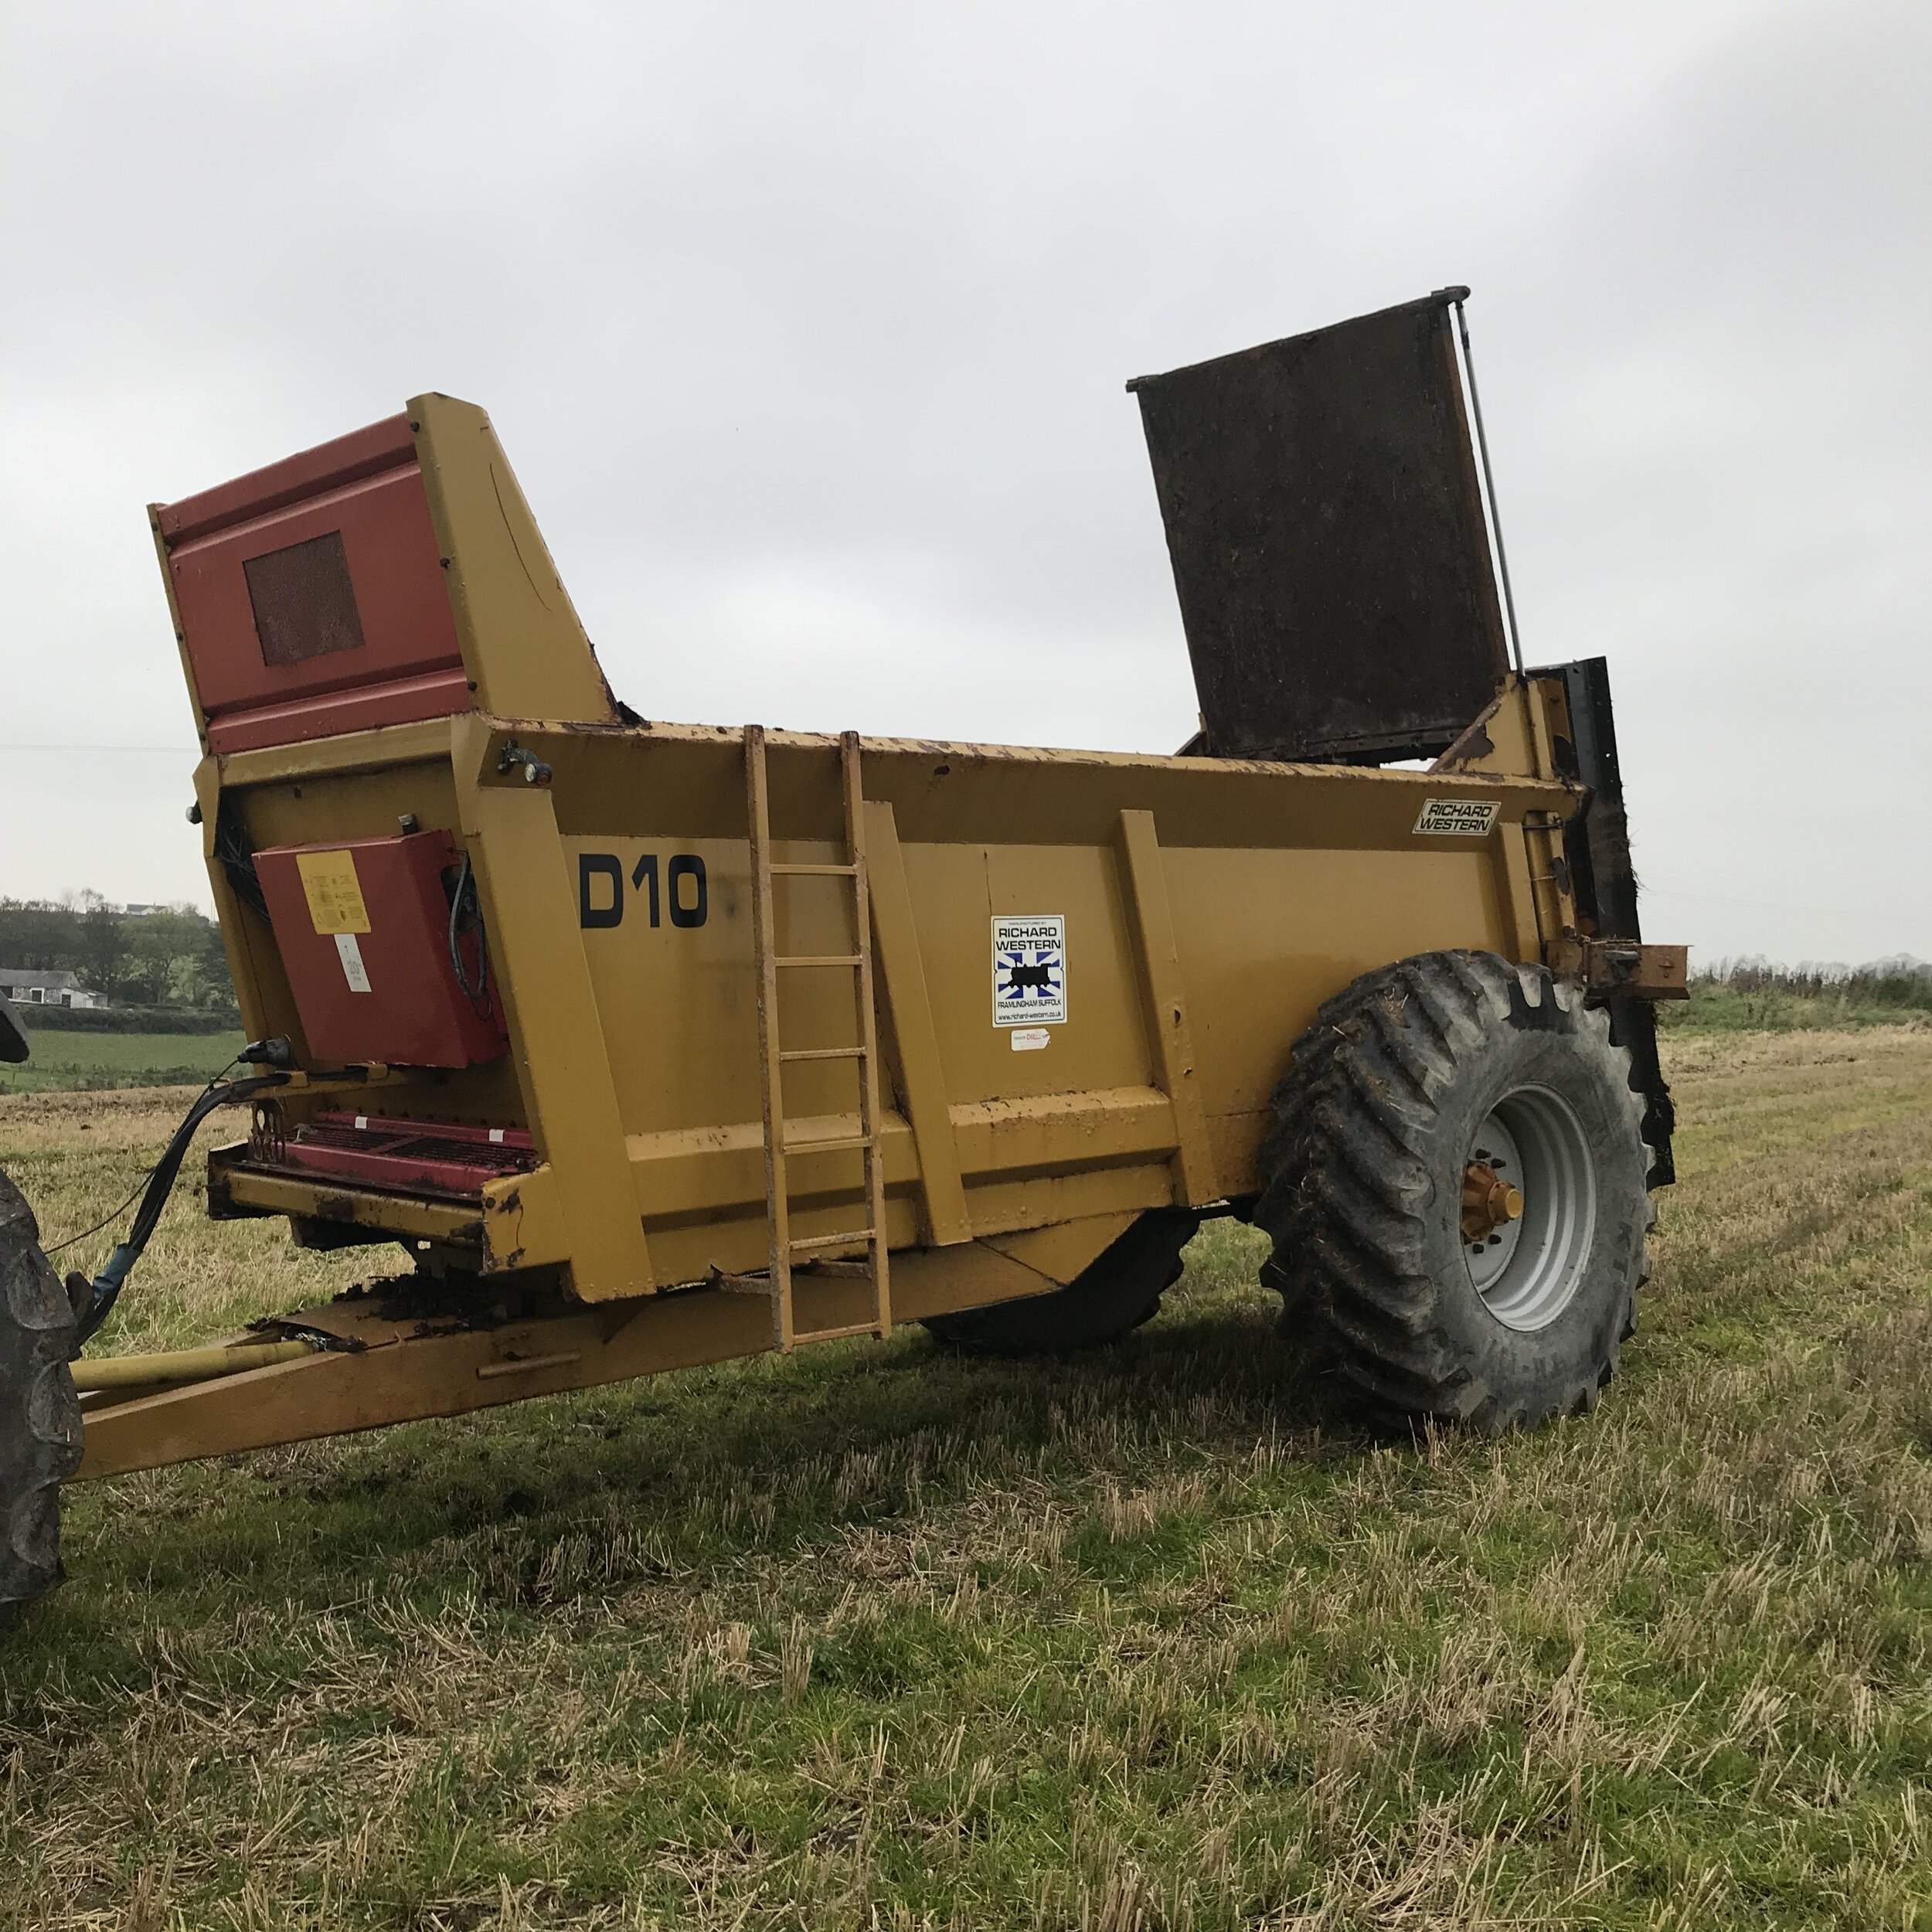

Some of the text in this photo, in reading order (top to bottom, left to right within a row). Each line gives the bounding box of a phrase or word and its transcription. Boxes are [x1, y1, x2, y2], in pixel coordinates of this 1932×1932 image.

[1428, 804, 1492, 818] RICHARD
[1420, 817, 1490, 831] WESTERN
[579, 853, 708, 929] D10
[998, 927, 1057, 938] RICHARD
[995, 939, 1061, 951] WESTERN
[998, 998, 1062, 1009] FRAMLINGHAM SUFFOLK
[998, 1010, 1062, 1021] www.richard-western.co.uk
